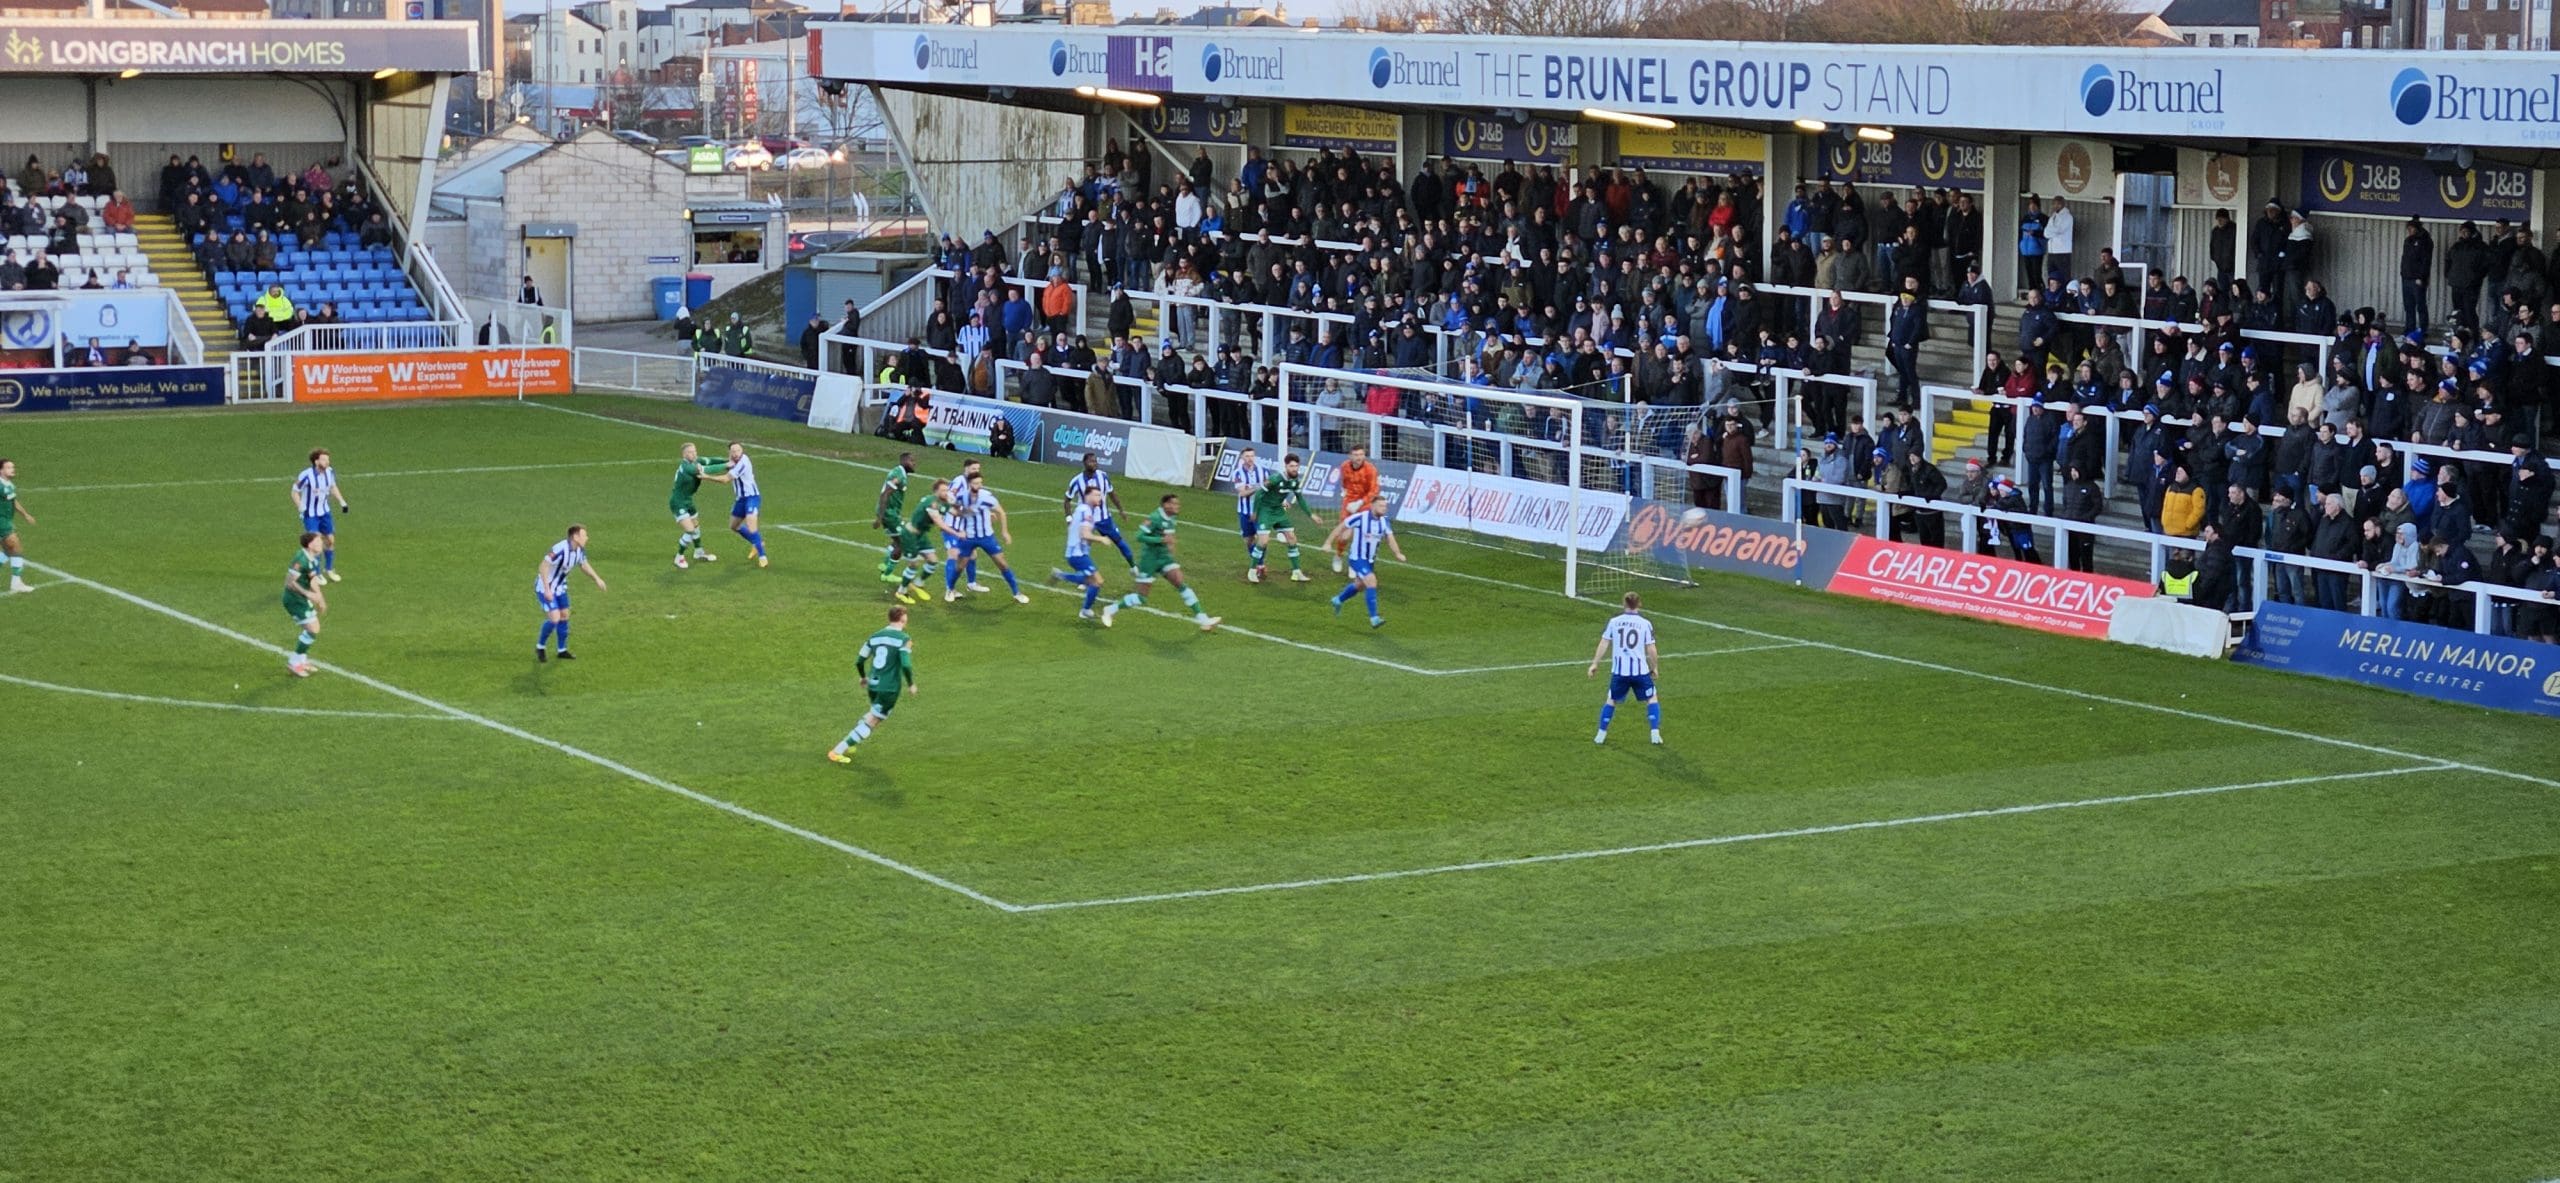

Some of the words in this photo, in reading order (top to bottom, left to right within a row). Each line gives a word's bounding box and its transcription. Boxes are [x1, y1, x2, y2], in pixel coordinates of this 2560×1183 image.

[52, 40, 246, 65] LONGBRANCH
[251, 41, 346, 65] HOMES
[930, 39, 978, 70] Brunel
[1069, 44, 1108, 74] Brun
[1223, 45, 1284, 81] Brunel
[1393, 51, 1462, 87] Brunel
[1475, 52, 1533, 97] THE
[1544, 54, 1679, 104] BRUNEL
[1689, 59, 1811, 109] GROUP
[1823, 62, 1950, 115] STAND
[2117, 69, 2224, 114] Brunel
[2434, 74, 2560, 123] Brunel
[1170, 108, 1190, 125] J&B
[2191, 120, 2226, 131] GROUP
[1296, 120, 1352, 135] MANAGEMENT
[1479, 122, 1504, 142] J&B
[222, 143, 234, 160] J
[694, 152, 720, 161] ASDA
[1672, 141, 1701, 154] SINCE
[1703, 142, 1727, 157] 1998
[1861, 143, 1893, 164] J&B
[1954, 146, 1985, 169] J&B
[2361, 164, 2401, 190] J&B
[2483, 170, 2526, 197] J&B
[2360, 191, 2401, 202] RECYCLING
[2482, 198, 2526, 209] RECYCLING
[332, 364, 384, 374] Workwear
[388, 362, 415, 382] W
[416, 361, 468, 371] Workwear
[482, 359, 510, 380] W
[511, 358, 561, 368] Workwear
[512, 368, 550, 379] Express
[303, 364, 330, 384] W
[332, 374, 373, 385] Express
[417, 372, 456, 382] Express
[31, 386, 51, 397] We
[55, 385, 95, 398] invest,
[98, 384, 119, 394] We
[122, 382, 155, 395] build,
[158, 382, 178, 392] We
[182, 383, 207, 392] care
[943, 407, 997, 431] TRAINING
[1456, 486, 1513, 523] GLOBAL
[1577, 505, 1615, 538] LTD
[1663, 518, 1808, 569] vanarama
[1868, 549, 1997, 595] CHARLES
[1994, 568, 2125, 617] DICKENS
[1905, 592, 1928, 604] Largest
[1927, 595, 1964, 610] Independent
[1964, 602, 1981, 612] Trade
[1998, 608, 2021, 619] Retailer
[2023, 612, 2041, 624] Open
[2045, 616, 2061, 628] Days
[2067, 620, 2086, 630] Week
[1618, 628, 1638, 650] 10
[873, 645, 889, 670] 8
[2338, 628, 2435, 662] MERLIN
[2438, 644, 2536, 680] MANOR
[2359, 662, 2404, 678] CARE
[2413, 671, 2485, 692] CENTRE
